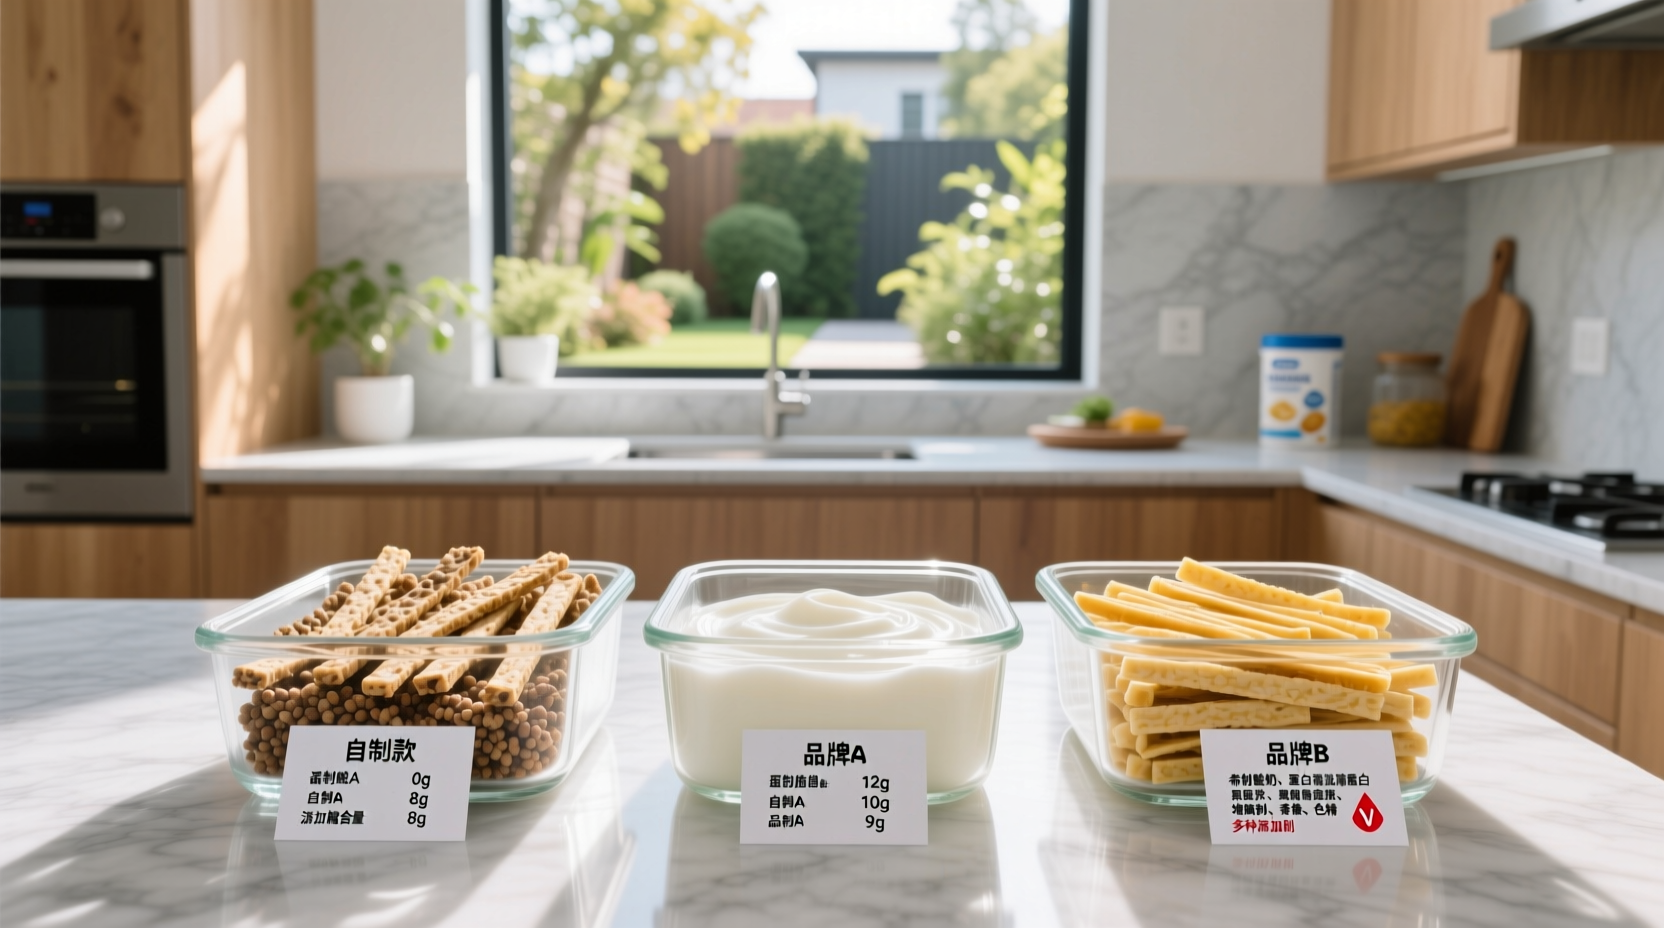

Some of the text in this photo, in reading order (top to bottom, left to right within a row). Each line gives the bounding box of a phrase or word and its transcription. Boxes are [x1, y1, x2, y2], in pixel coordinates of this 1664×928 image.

[345, 737, 417, 763] 自制款
[803, 741, 867, 767] 品牌A
[1266, 740, 1330, 767] 品牌B
[411, 771, 431, 790] 0g
[862, 774, 890, 793] 12g
[408, 791, 429, 810] 8g
[861, 795, 890, 814] 10g
[406, 809, 427, 829] 8g
[865, 814, 885, 833] 9g
